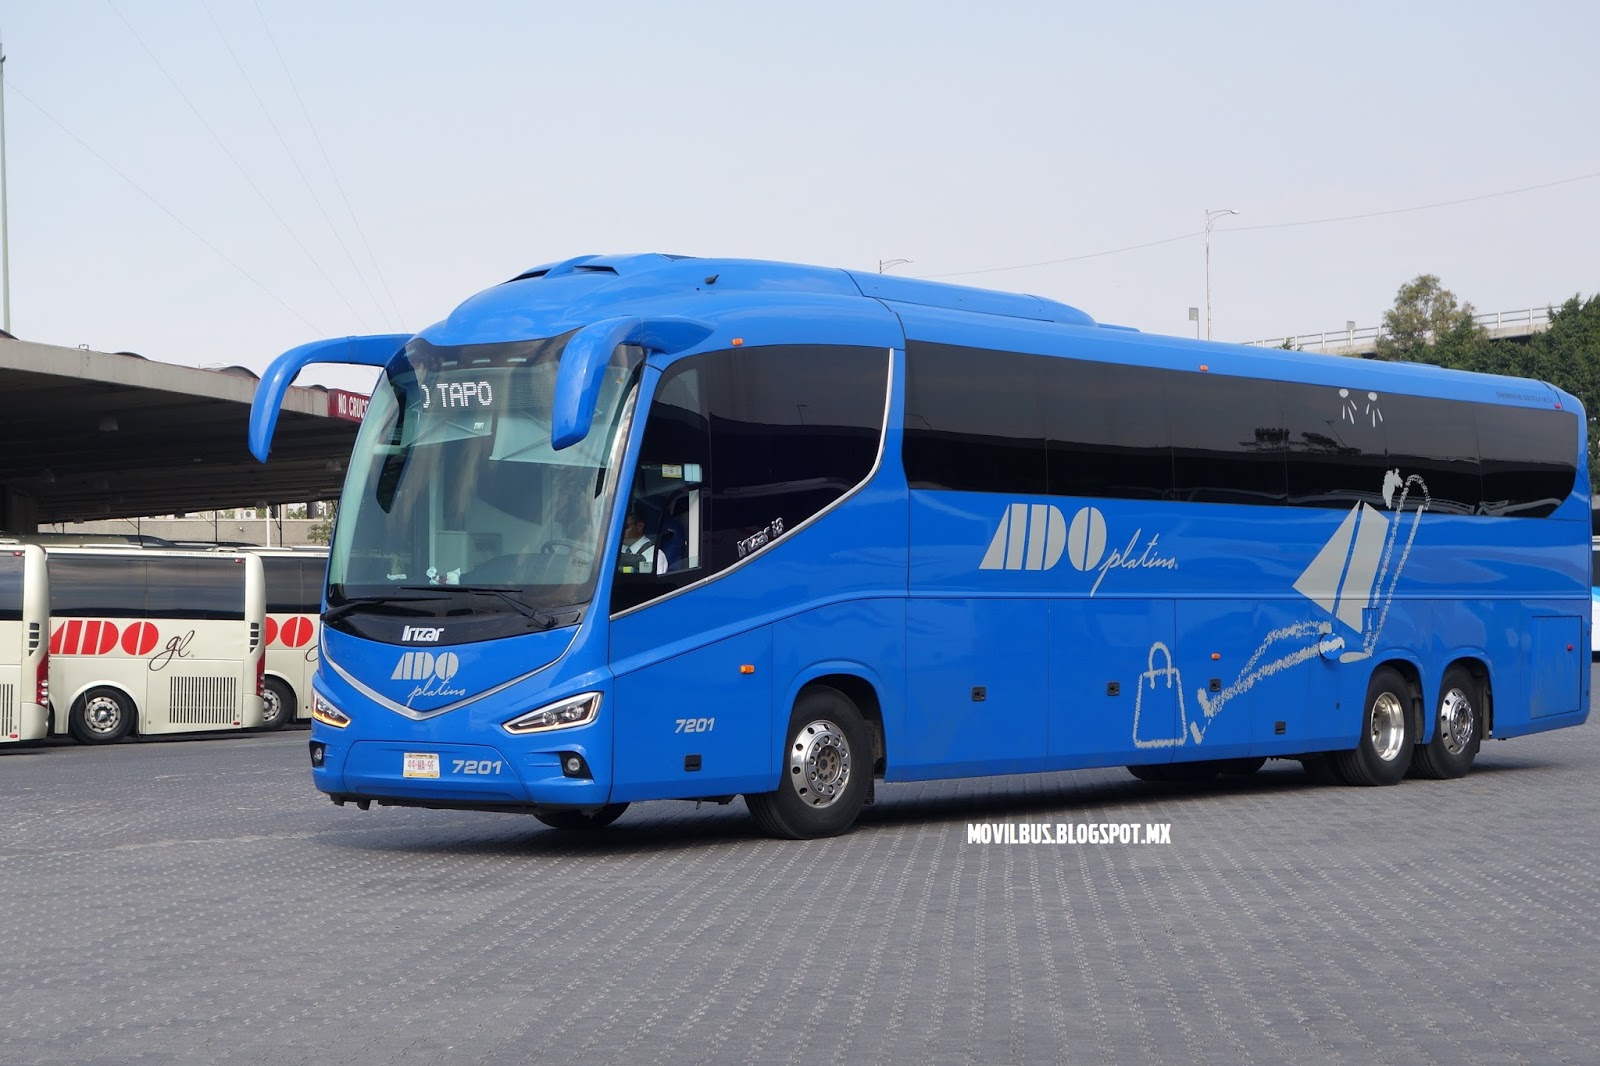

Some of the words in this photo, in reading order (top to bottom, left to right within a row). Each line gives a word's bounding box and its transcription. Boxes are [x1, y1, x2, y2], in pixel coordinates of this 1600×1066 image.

[338, 393, 347, 415] NO
[437, 381, 493, 408] TAPO
[978, 503, 1107, 572] ADO
[401, 625, 445, 642] Irizar
[390, 651, 459, 680] ADO
[674, 717, 716, 734] 7201
[452, 759, 502, 775] 7201
